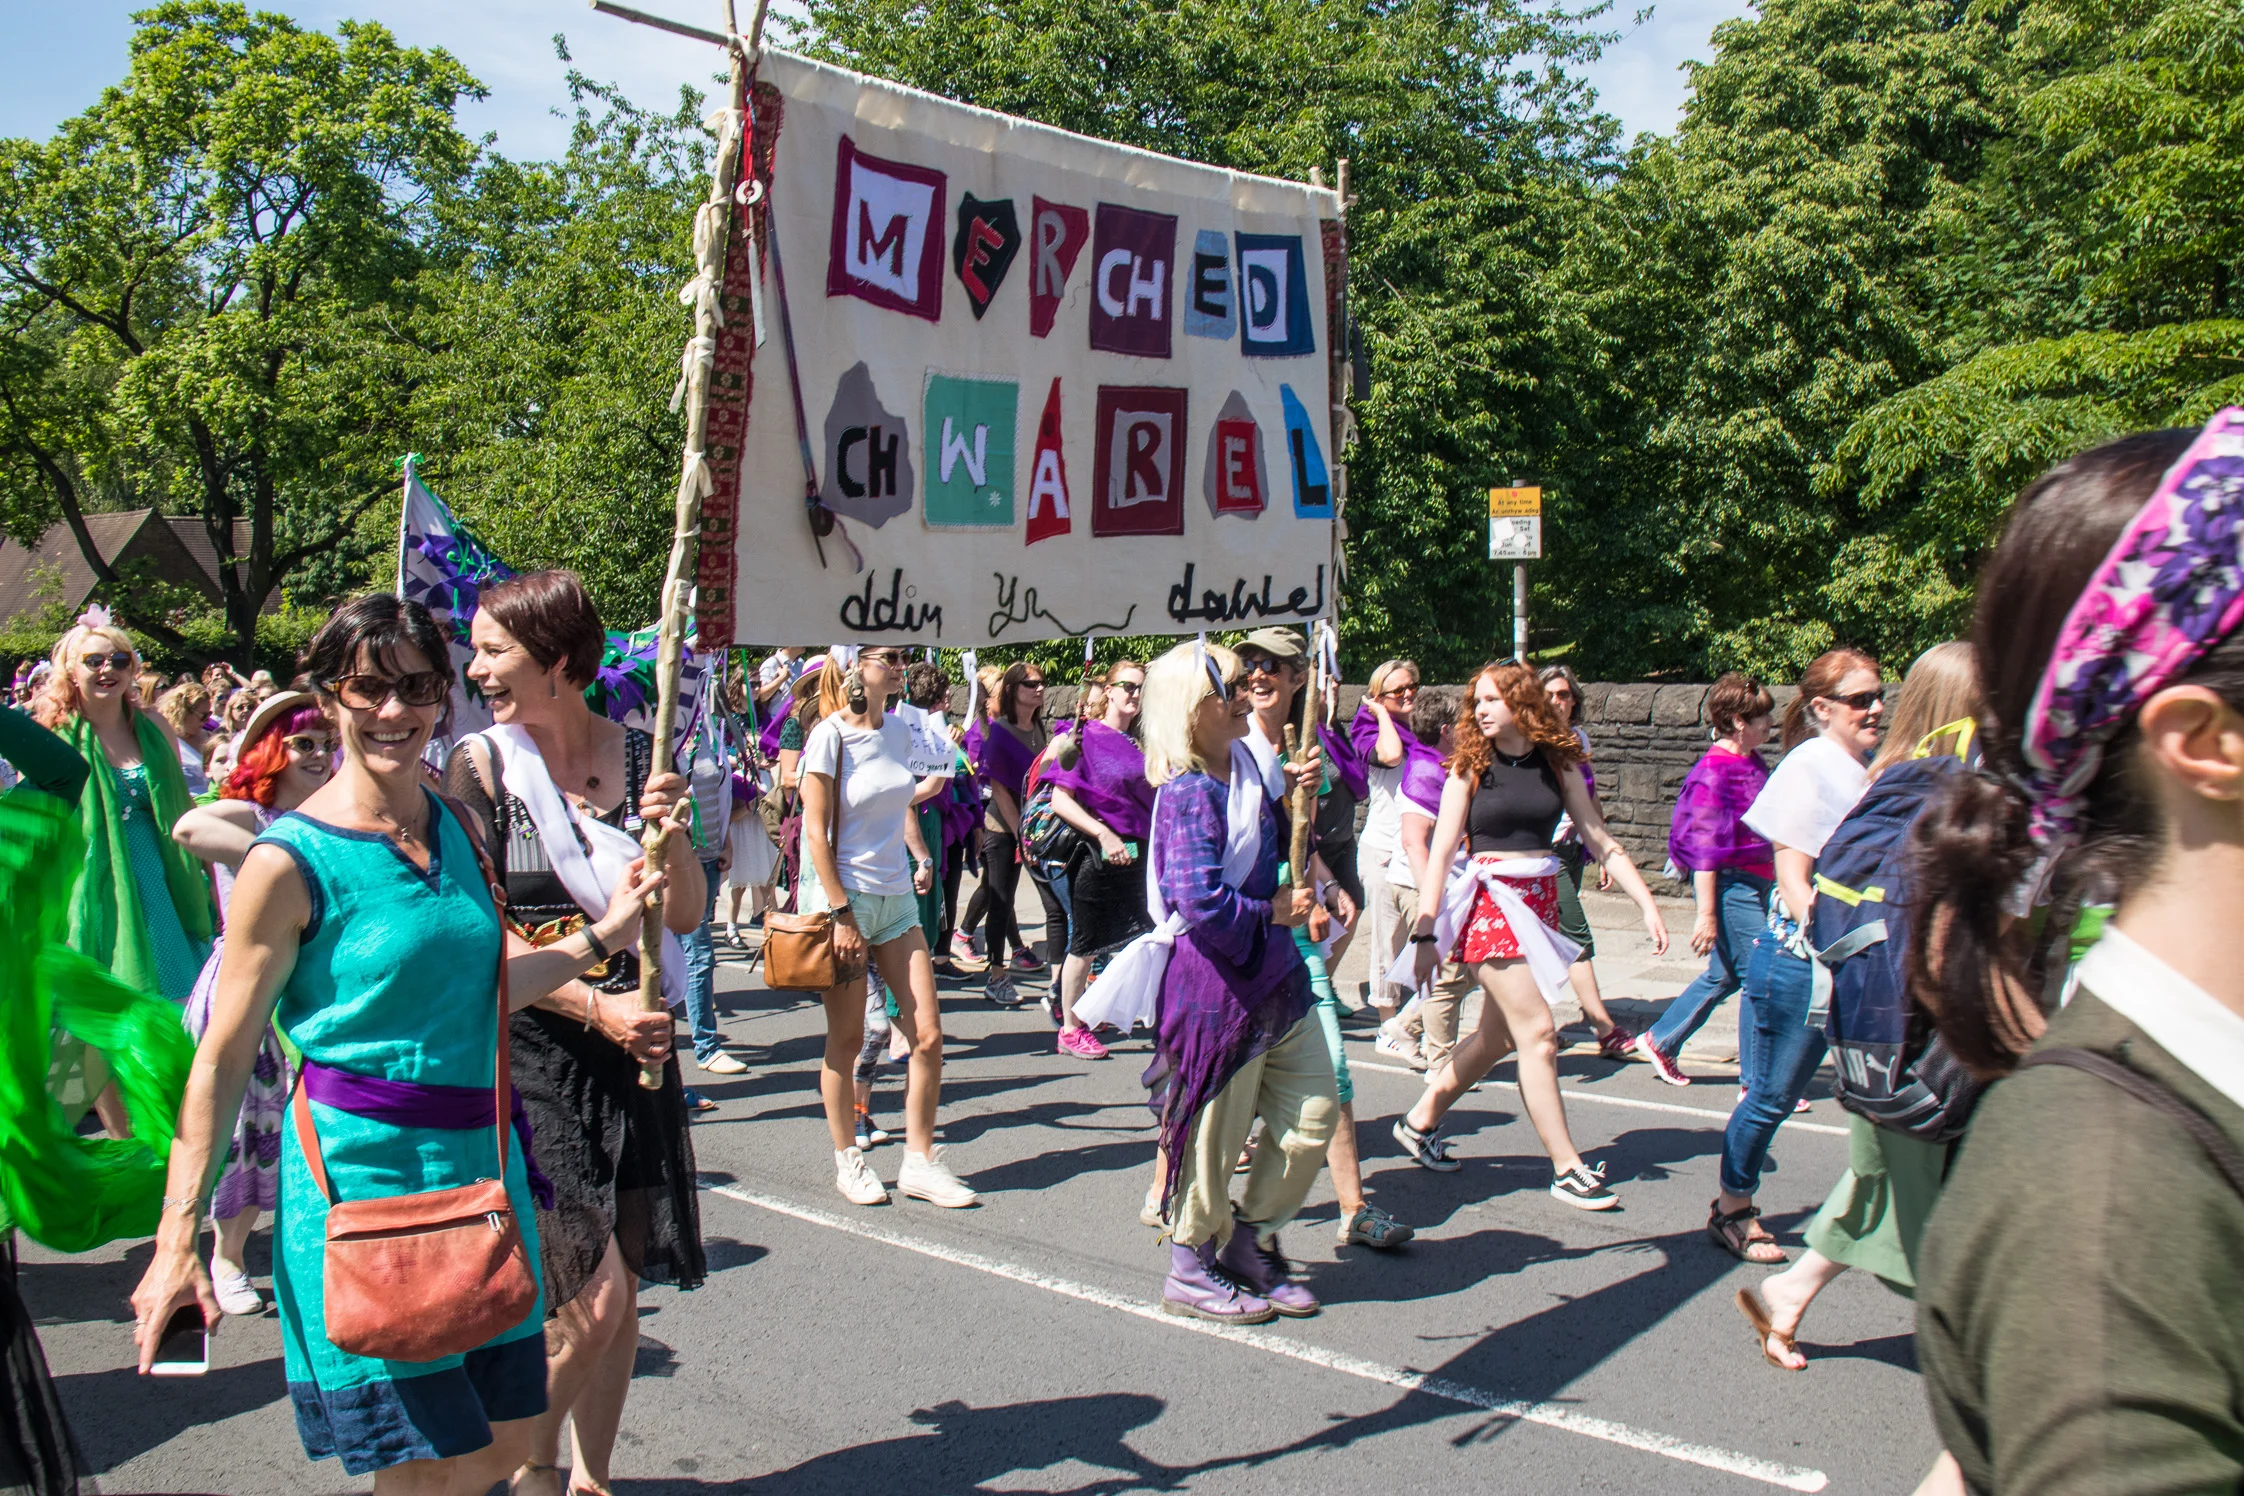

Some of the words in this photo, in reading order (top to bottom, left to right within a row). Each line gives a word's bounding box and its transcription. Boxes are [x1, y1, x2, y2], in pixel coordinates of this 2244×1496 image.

[856, 197, 1280, 331] MERCHED
[836, 415, 1328, 520] CHWAREL
[909, 760, 925, 771] 100
[926, 762, 944, 772] years
